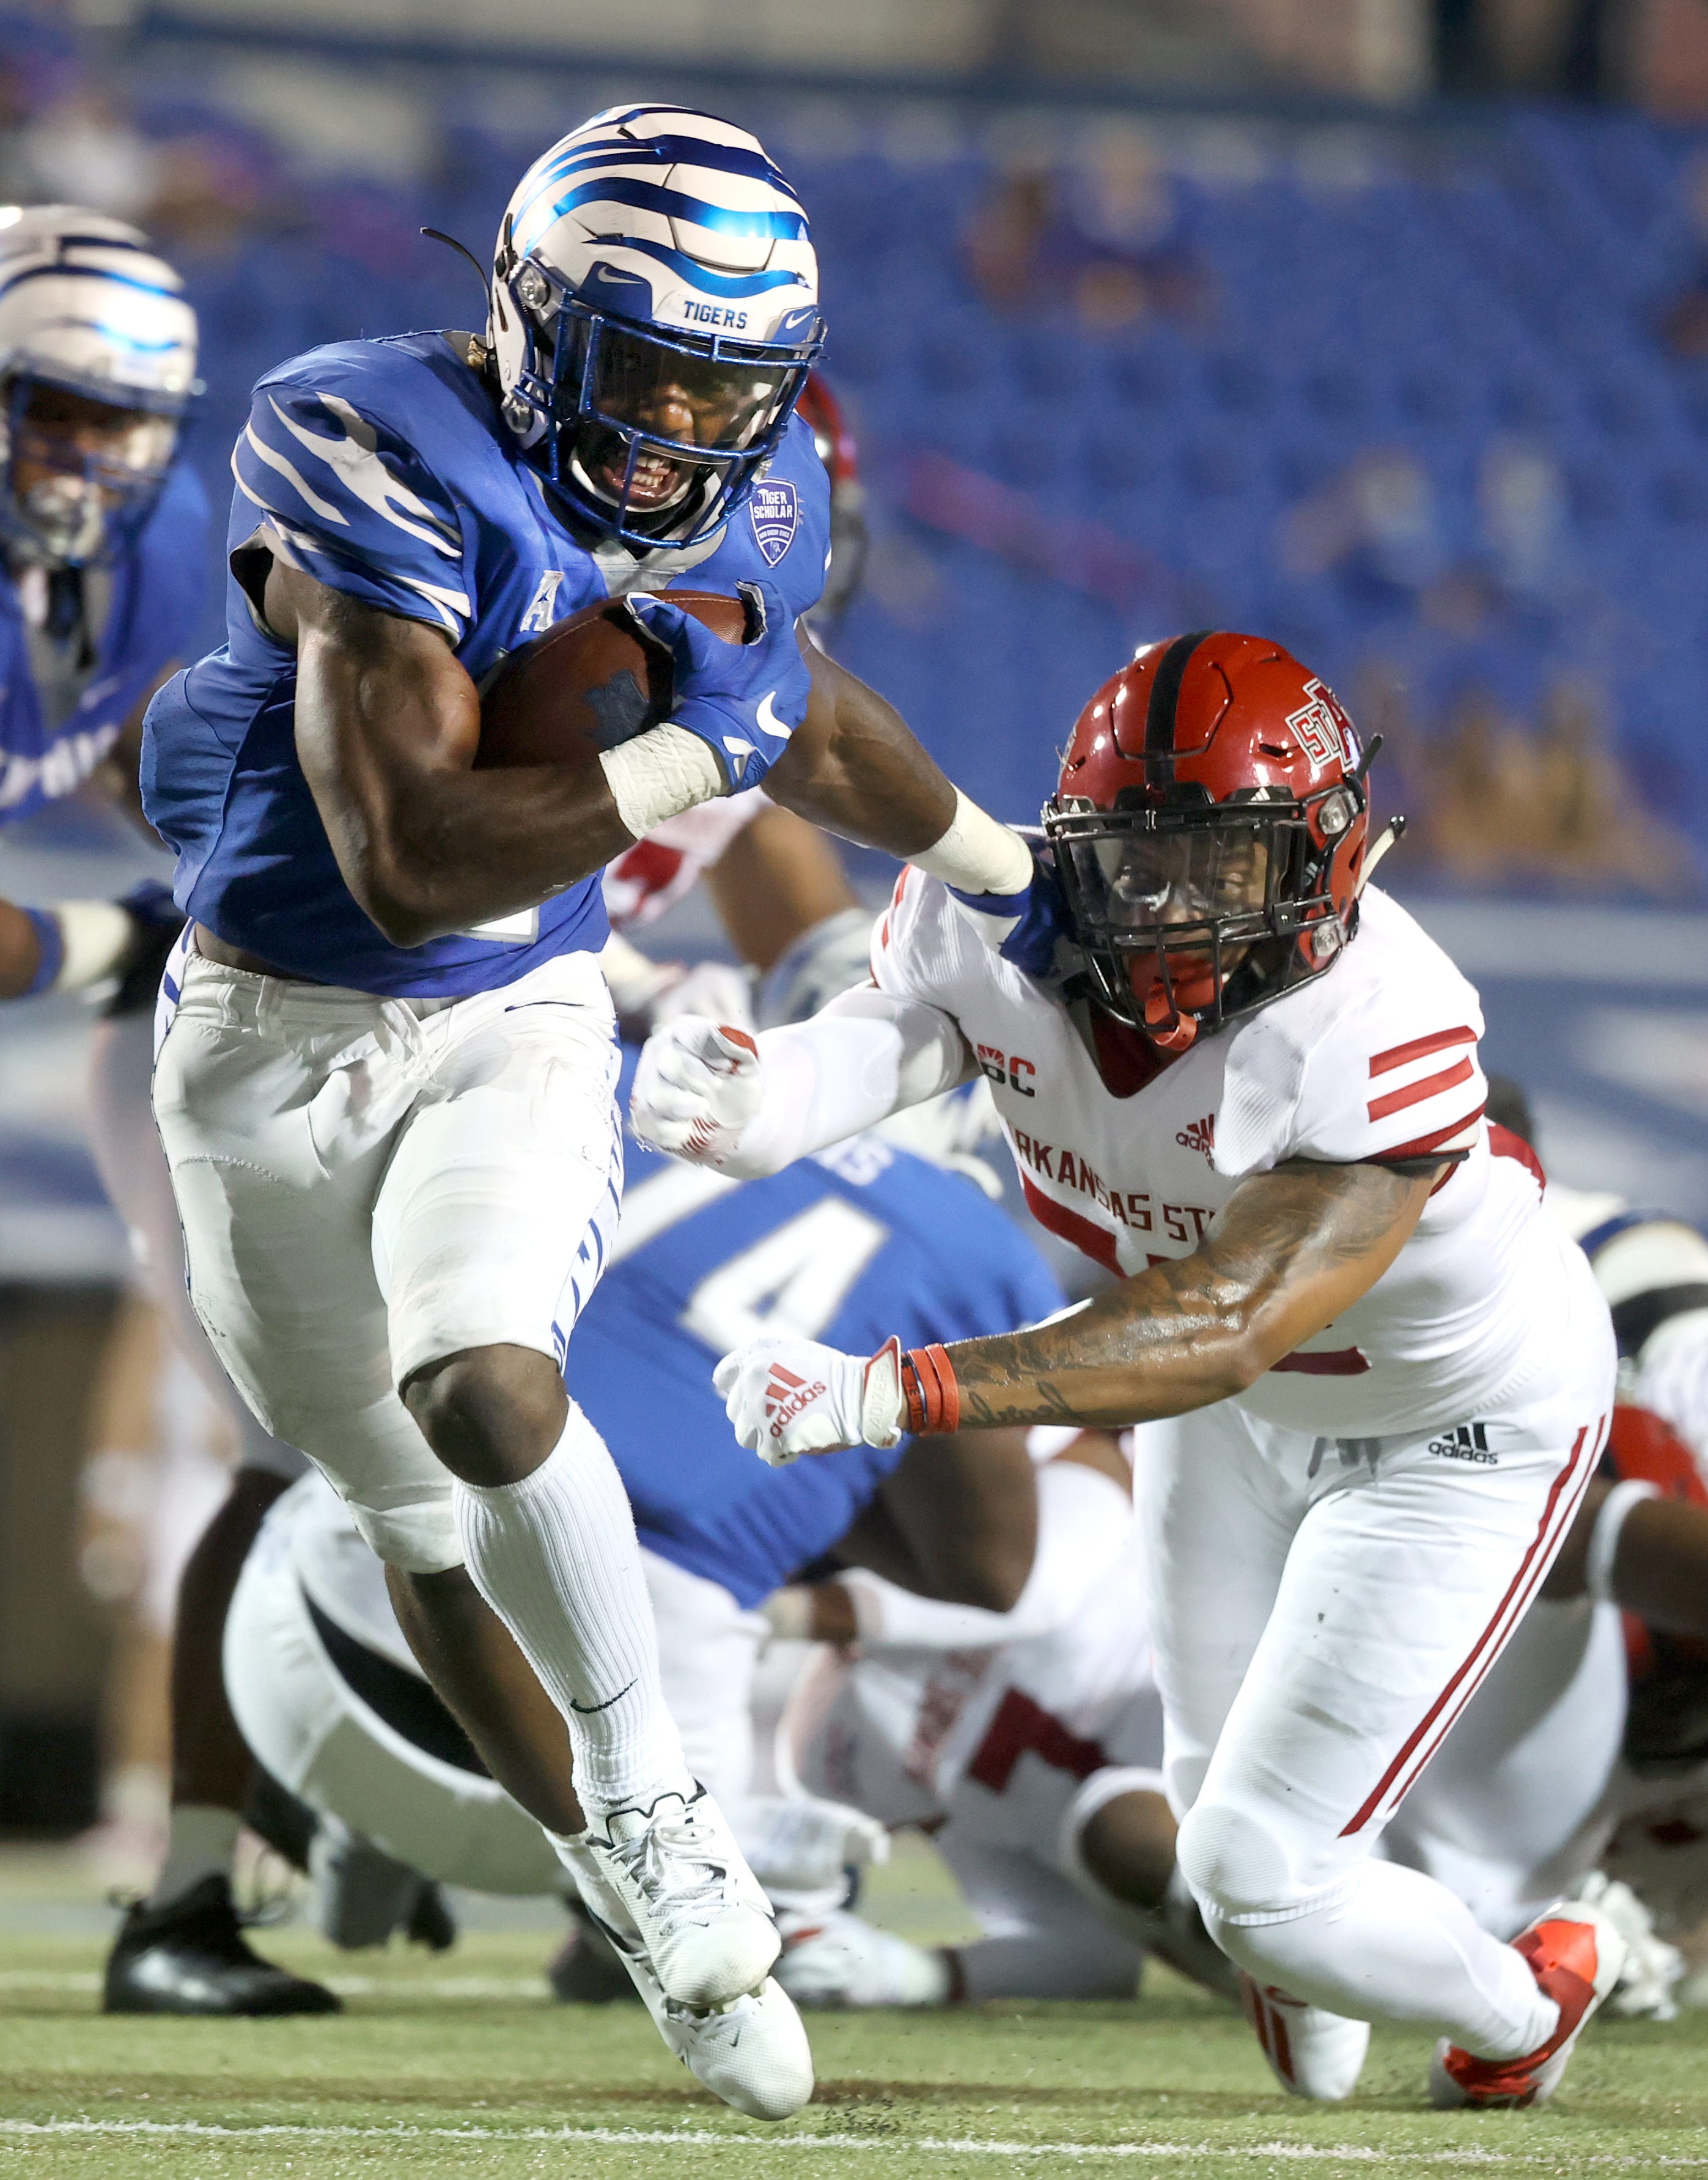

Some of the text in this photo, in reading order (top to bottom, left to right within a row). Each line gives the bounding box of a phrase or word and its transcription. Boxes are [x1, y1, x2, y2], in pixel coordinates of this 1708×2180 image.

[684, 300, 748, 330] TIGERS
[754, 504, 793, 519] SCHOLAR
[762, 491, 787, 505] TIGER
[1014, 1129, 1215, 1242] RKANSAS ST
[769, 1380, 826, 1437] adidas
[1428, 1441, 1498, 1465] adidas
